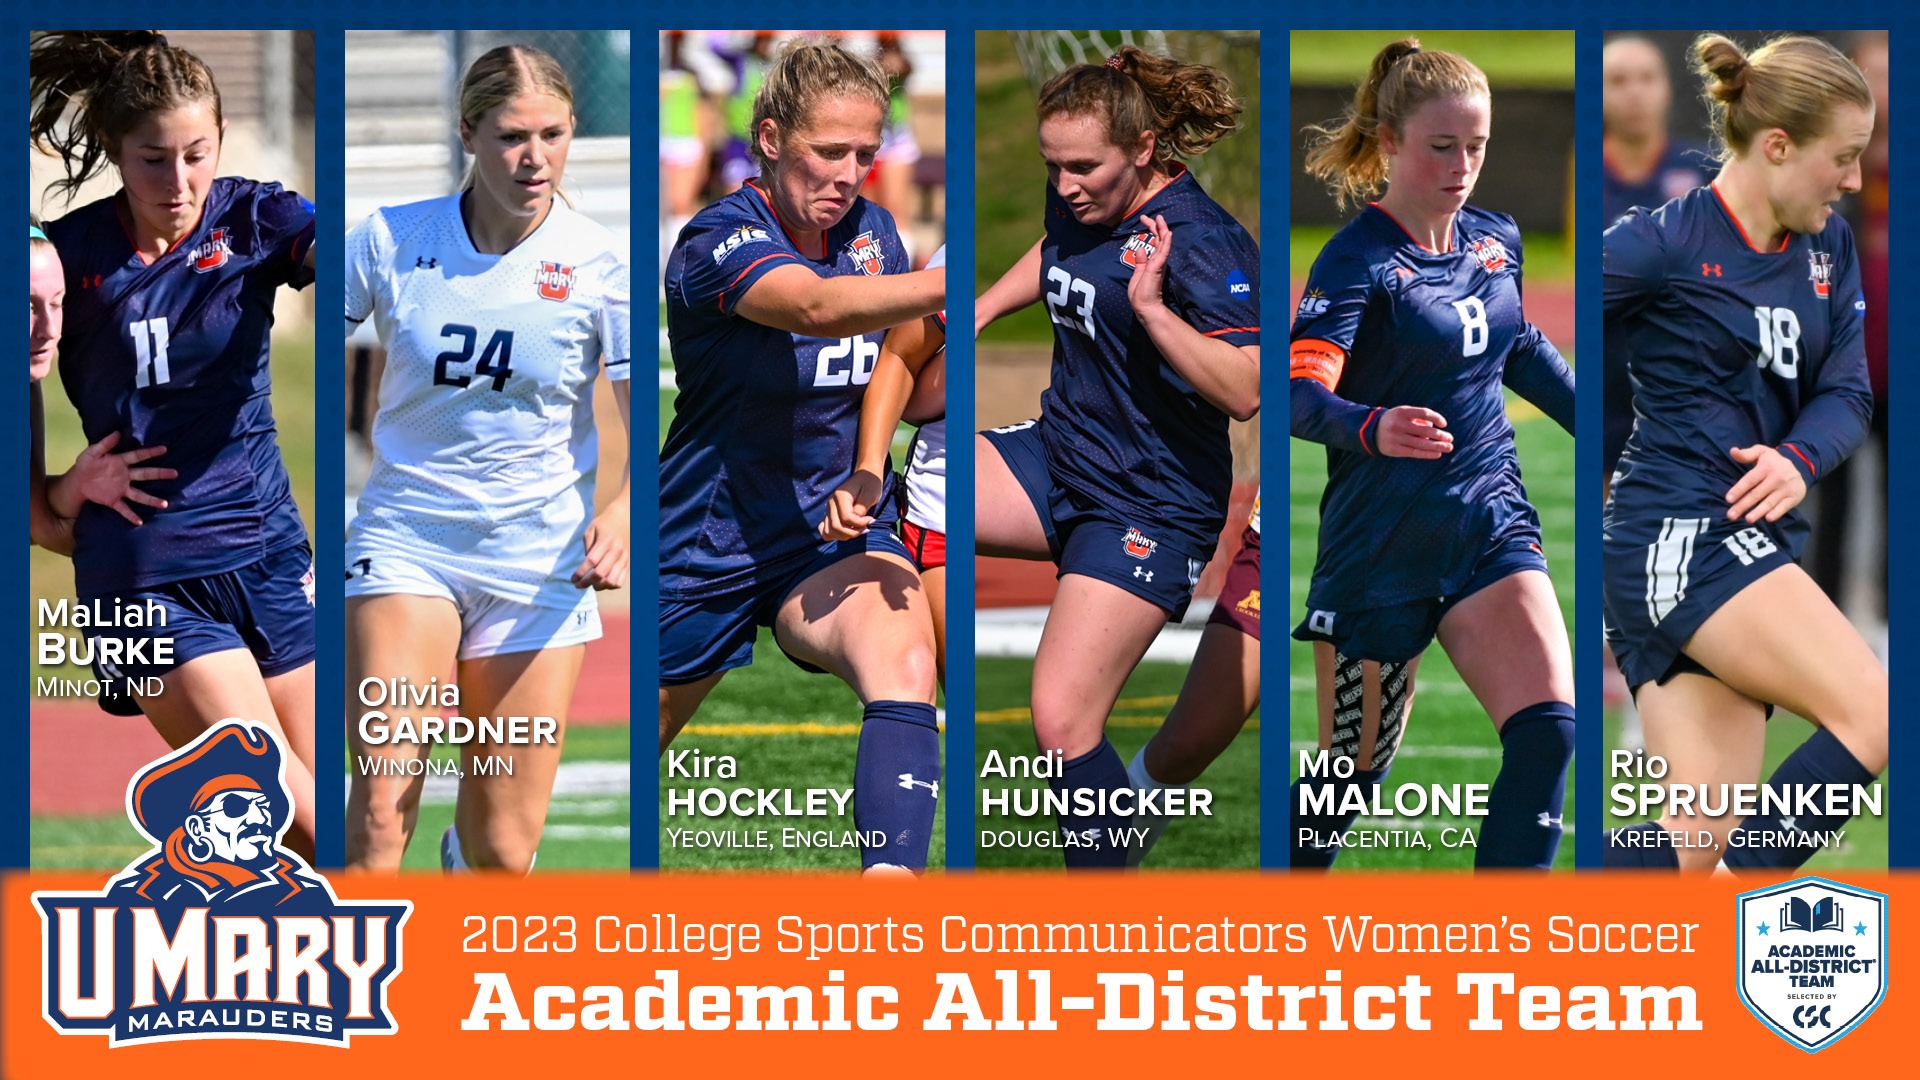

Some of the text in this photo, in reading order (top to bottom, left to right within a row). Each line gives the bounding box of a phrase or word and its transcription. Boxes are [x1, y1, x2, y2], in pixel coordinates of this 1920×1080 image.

[712, 229, 770, 262] NSIC
[534, 269, 577, 290] MARY
[1047, 266, 1096, 341] 23
[1230, 283, 1251, 294] NCAA
[129, 316, 170, 390] 11
[1451, 296, 1489, 357] 8
[1754, 306, 1801, 379] 18
[433, 323, 515, 393] 24
[813, 334, 880, 388] 26
[1721, 527, 1778, 566] 18
